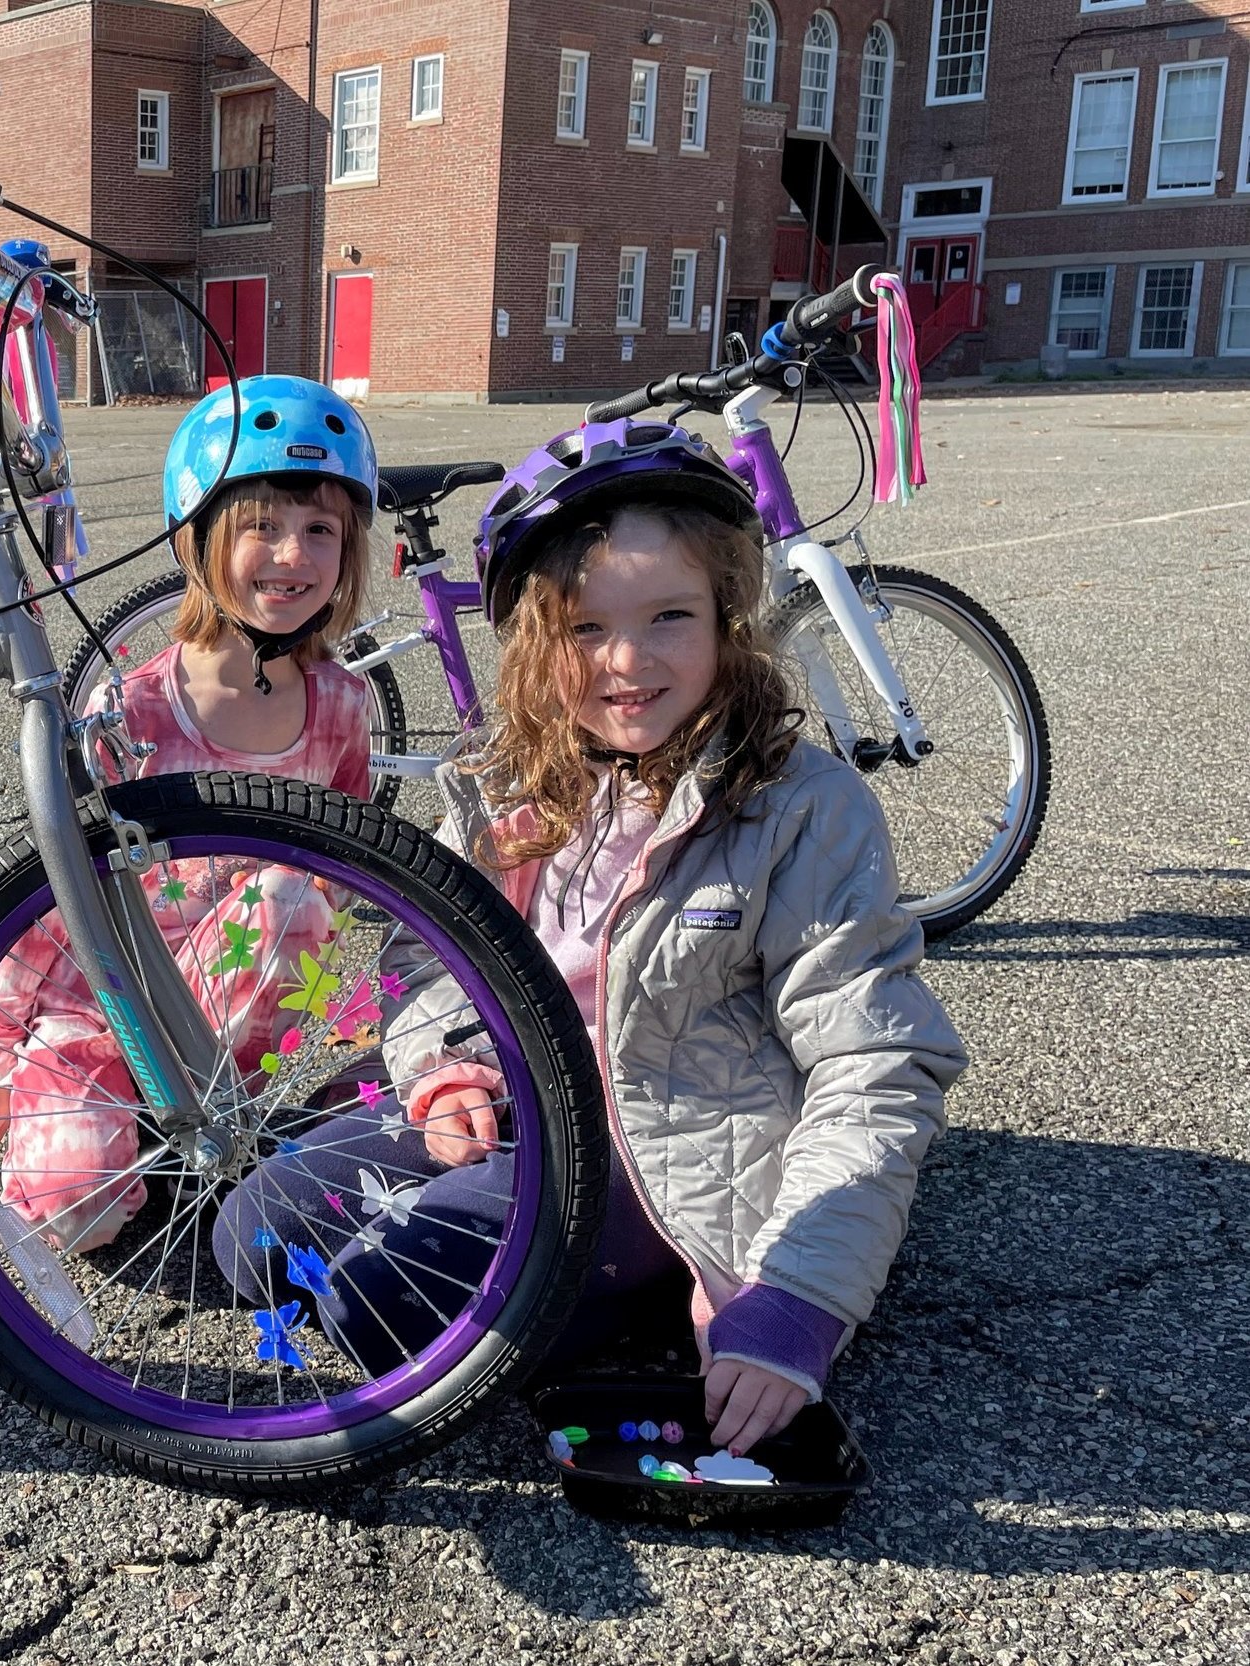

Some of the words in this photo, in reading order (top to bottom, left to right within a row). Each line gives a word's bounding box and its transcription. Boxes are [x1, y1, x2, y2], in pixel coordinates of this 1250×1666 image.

[291, 446, 323, 458] nutcase
[898, 697, 914, 718] 20
[685, 917, 735, 929] patagonia
[96, 989, 166, 1108] SCHWINN
